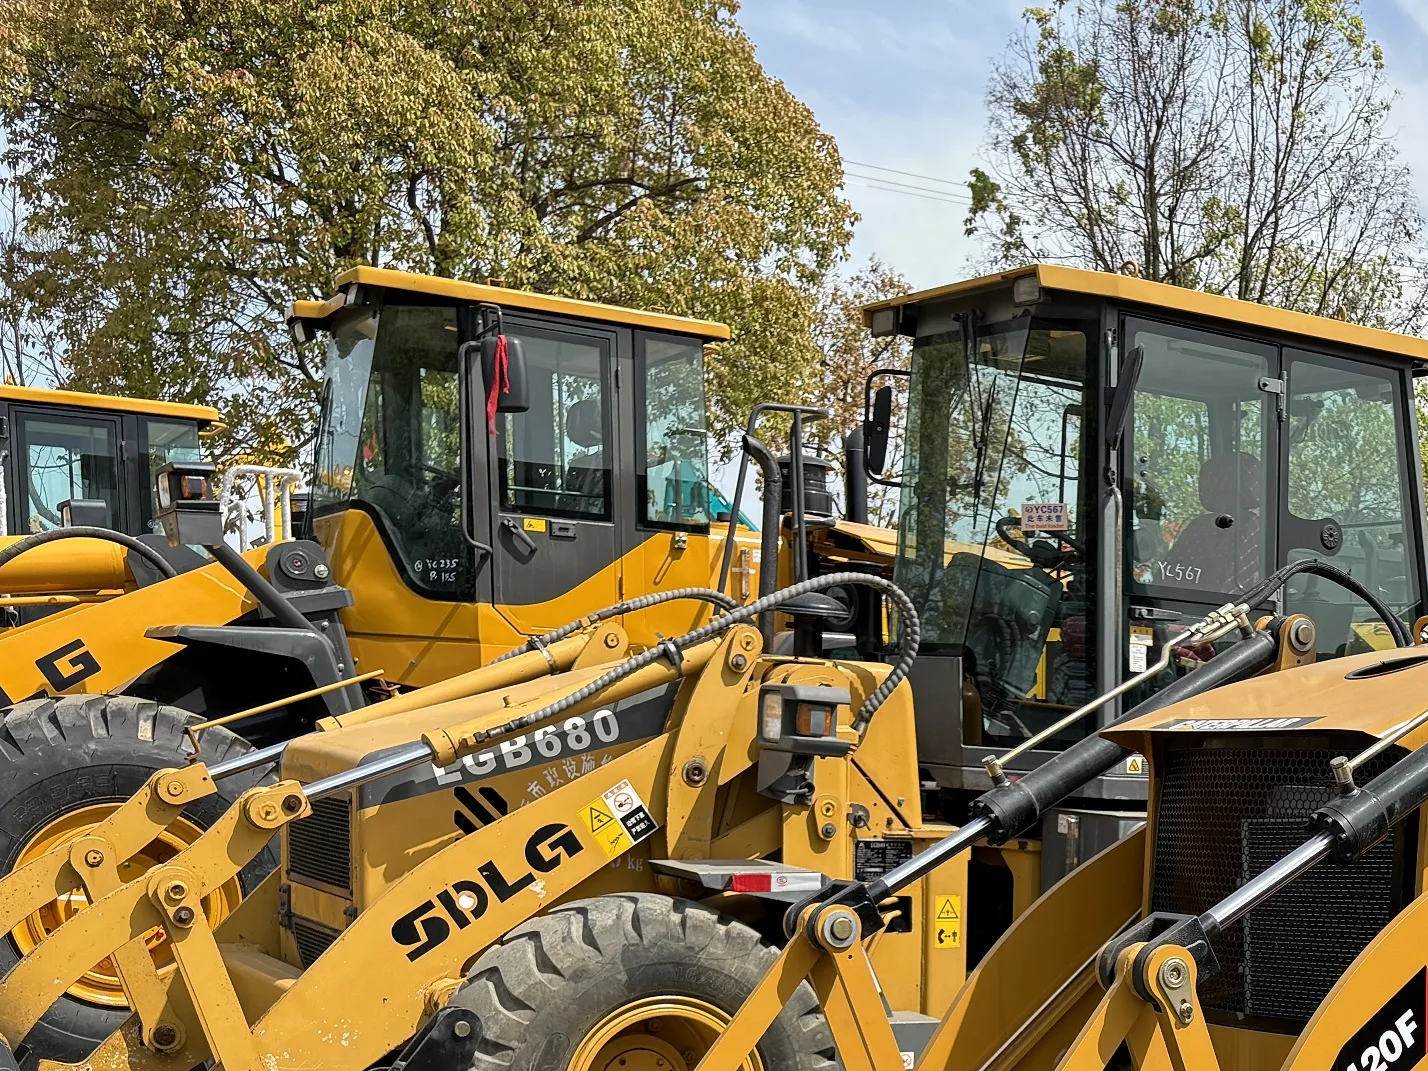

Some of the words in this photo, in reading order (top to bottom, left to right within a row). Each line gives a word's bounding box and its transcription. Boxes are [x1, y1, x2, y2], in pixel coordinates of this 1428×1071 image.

[1033, 505, 1064, 514] YC567
[627, 855, 643, 872] kg
[392, 823, 584, 962] SDLG
